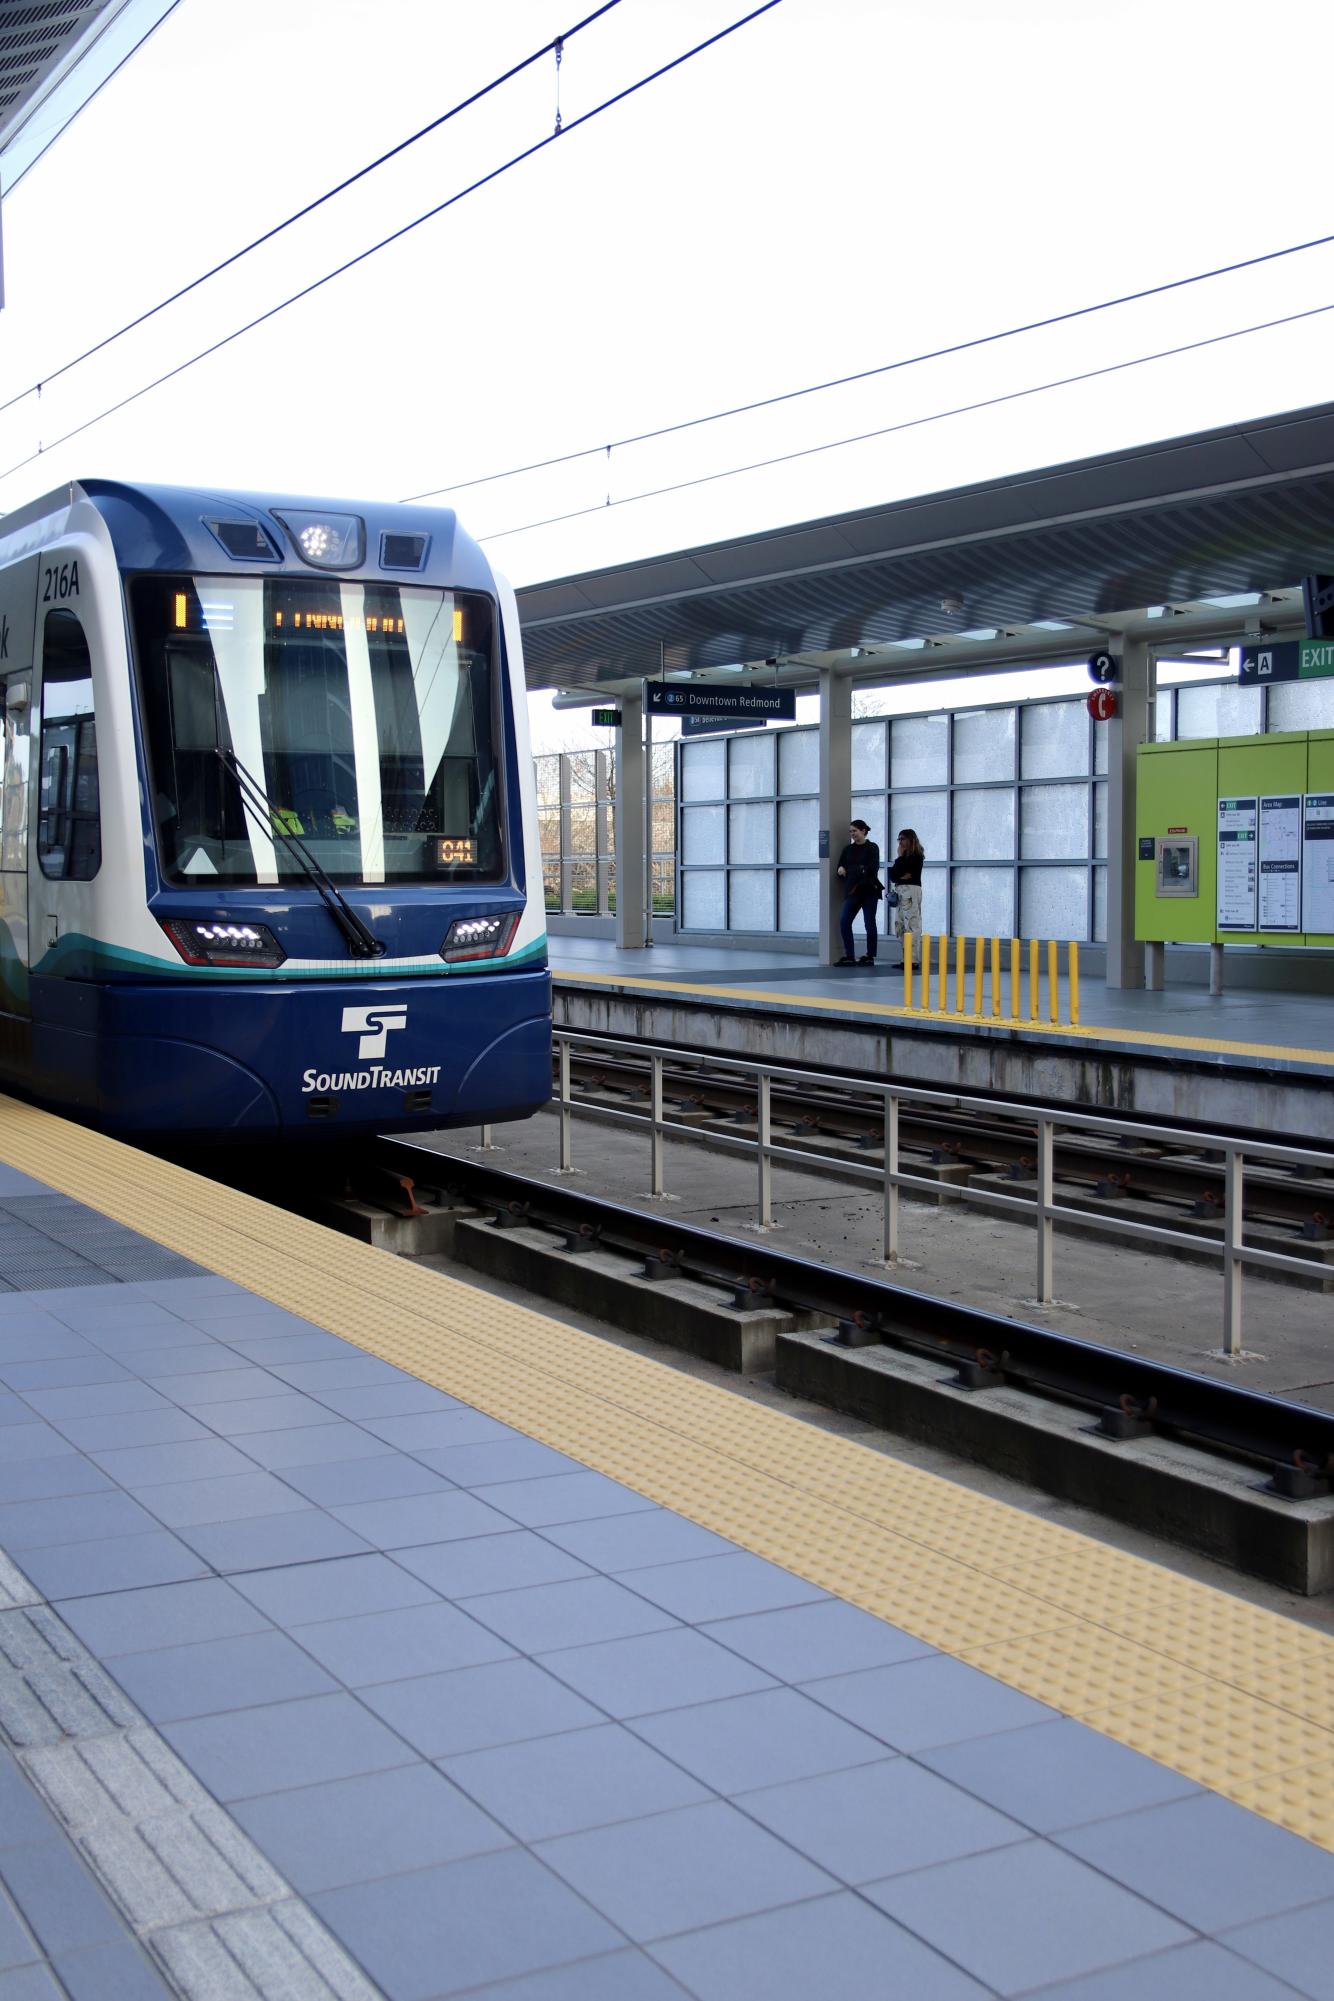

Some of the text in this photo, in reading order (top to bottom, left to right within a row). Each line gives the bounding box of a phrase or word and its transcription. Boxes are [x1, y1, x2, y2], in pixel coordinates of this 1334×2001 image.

[43, 561, 79, 602] 216A
[1260, 655, 1270, 671] A
[1302, 646, 1334, 668] EXIT
[689, 694, 737, 706] Downtown
[740, 696, 781, 708] Redmond
[442, 840, 472, 862] 041
